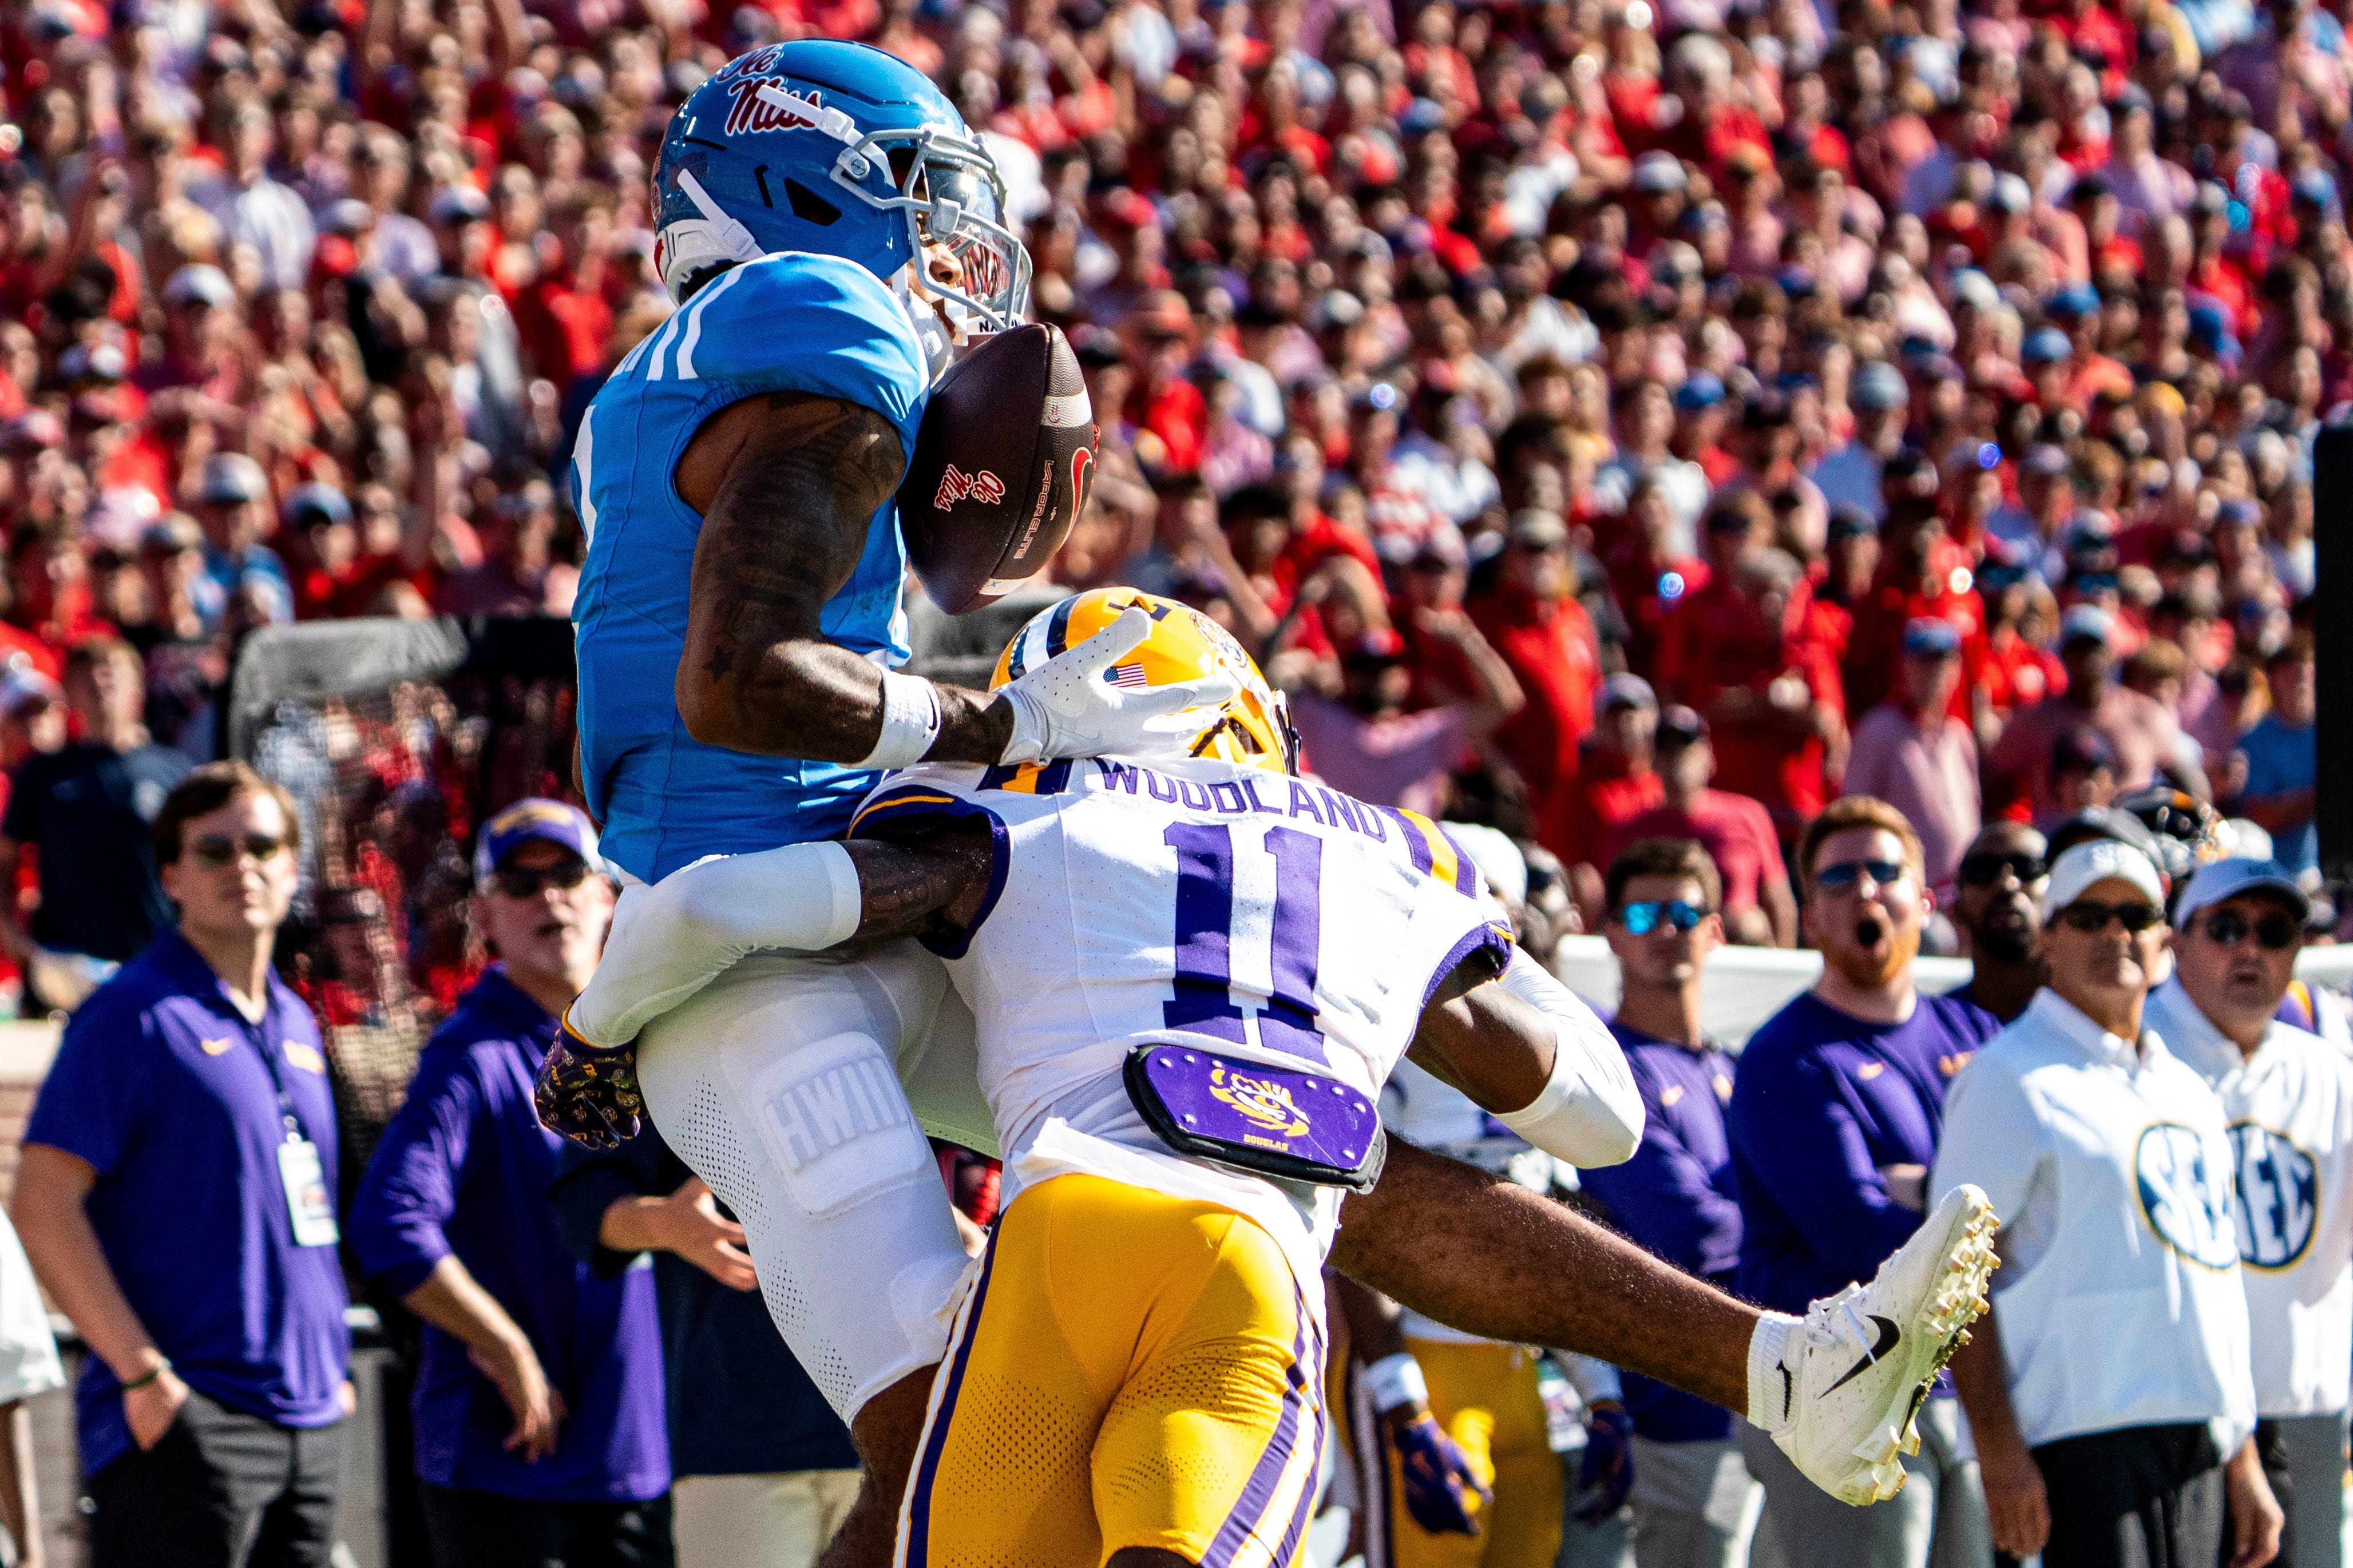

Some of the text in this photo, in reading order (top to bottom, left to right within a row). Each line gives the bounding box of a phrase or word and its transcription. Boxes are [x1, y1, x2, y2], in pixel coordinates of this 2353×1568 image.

[934, 464, 973, 512] Miss
[972, 470, 1005, 505] Ole
[1013, 460, 1054, 559] VAPOR ELITE
[1092, 756, 1387, 843] WOODLAND
[1163, 821, 1332, 1069] 11
[1244, 1134, 1289, 1152] DOUGLAS
